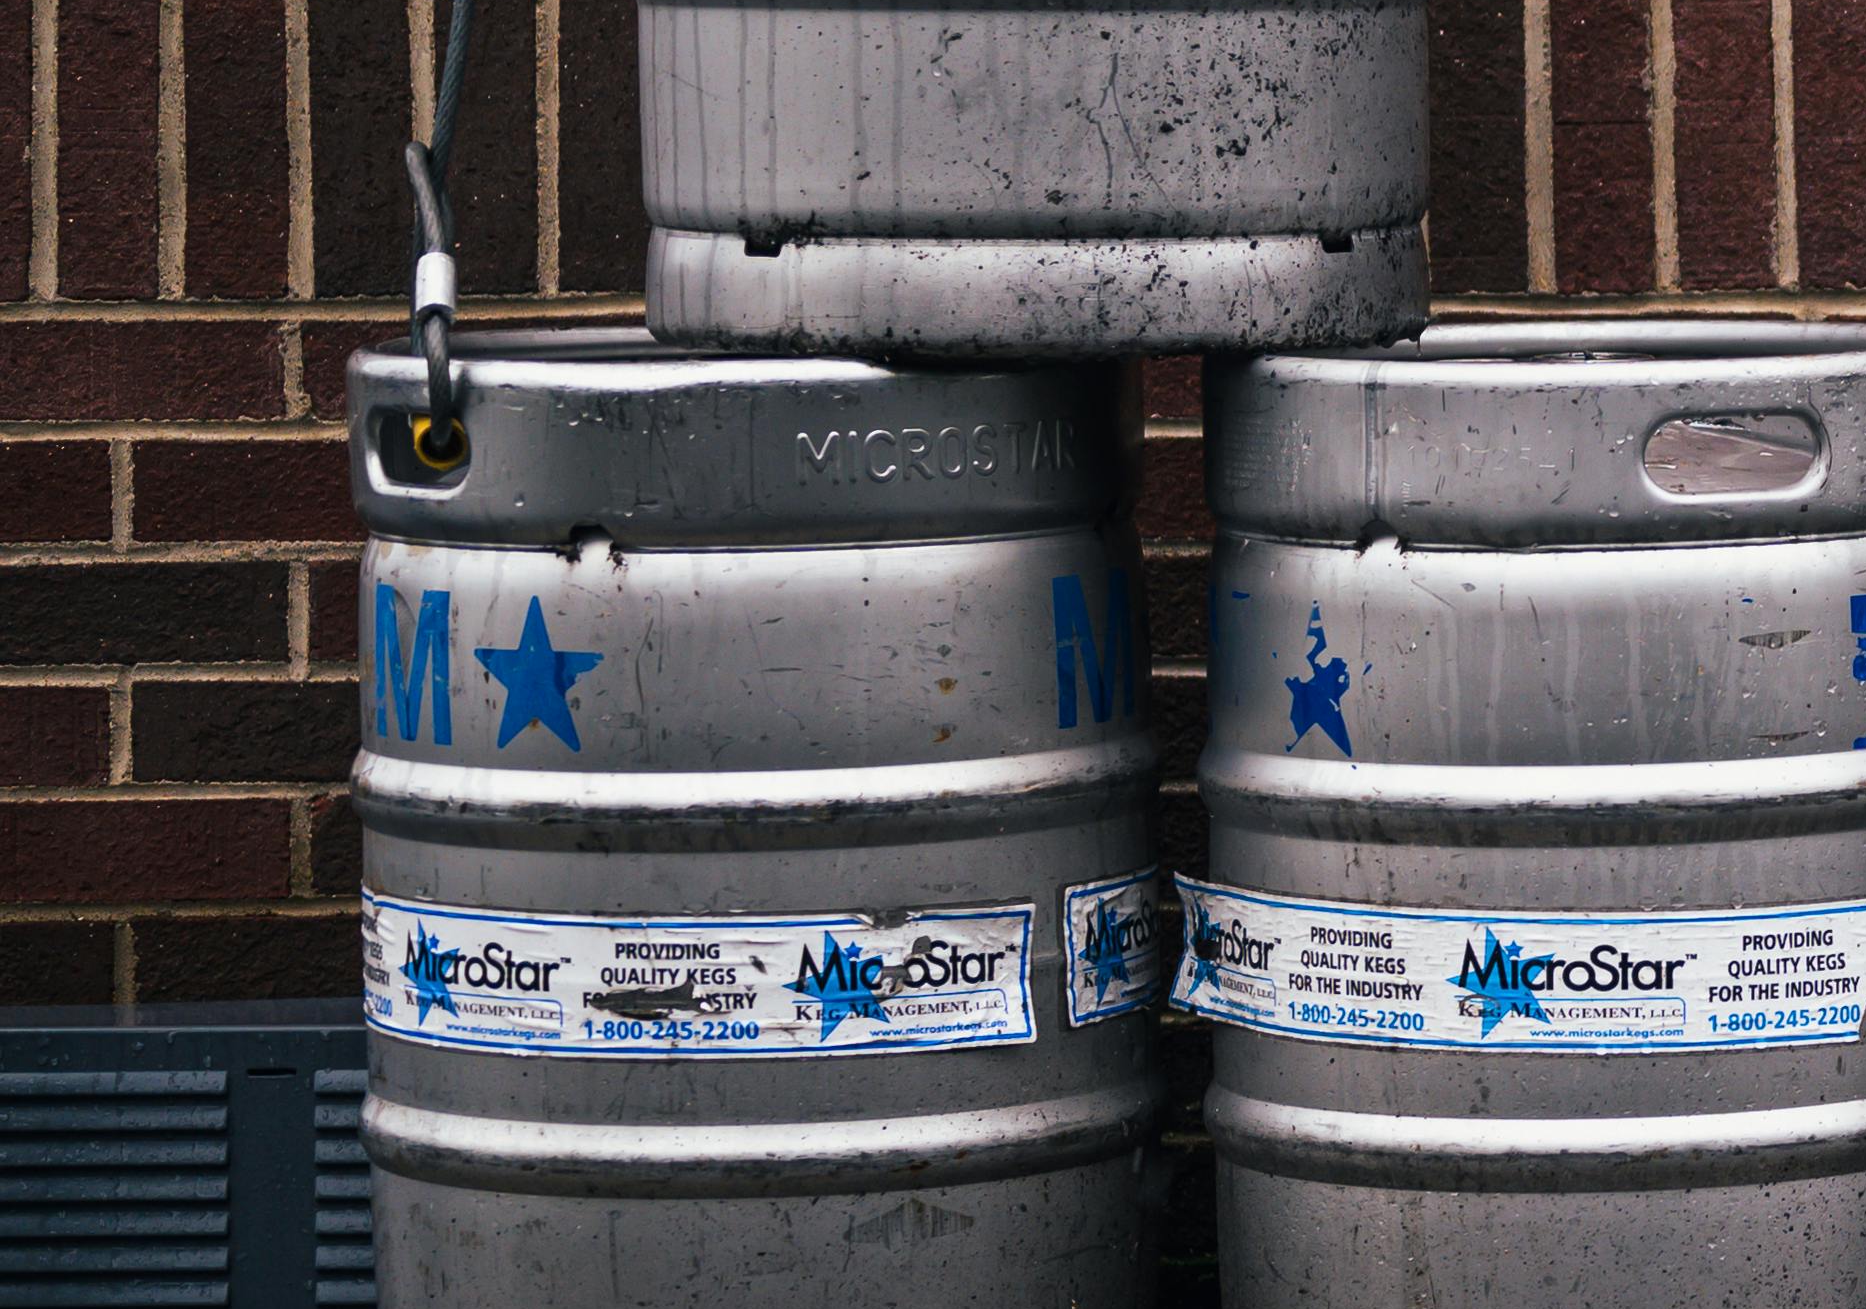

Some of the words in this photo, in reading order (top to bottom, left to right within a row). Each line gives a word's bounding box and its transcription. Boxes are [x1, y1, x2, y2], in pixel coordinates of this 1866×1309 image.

[797, 419, 1076, 486] MICROSTAR
[1051, 569, 1137, 729] M
[374, 583, 452, 747] M
[1310, 926, 1392, 949] PROVIDING
[1742, 929, 1834, 952] PROVIDING
[614, 942, 721, 960] PROVIDING
[1300, 950, 1360, 971] QUALITY
[1364, 955, 1406, 975] KEGS
[600, 967, 680, 987] QUALITY
[686, 967, 737, 985] KEGS
[1728, 956, 1801, 979] QUALITY
[1806, 952, 1846, 973] KEGS
[1288, 973, 1312, 992] FOR
[1316, 976, 1341, 995] THE
[1345, 979, 1424, 1001] INDUSTRY
[1708, 985, 1743, 1003] FOR
[1749, 983, 1780, 1001] THE
[1785, 976, 1861, 998] INDUSTRY
[1288, 1001, 1425, 1031] 1-800-245-2200
[1457, 1000, 1500, 1018] KEG
[1708, 1004, 1861, 1032] 1-800-245-2200
[583, 1020, 760, 1040] 1-800-245-2200
[1529, 1026, 1684, 1039] www.microstarkegs.com
